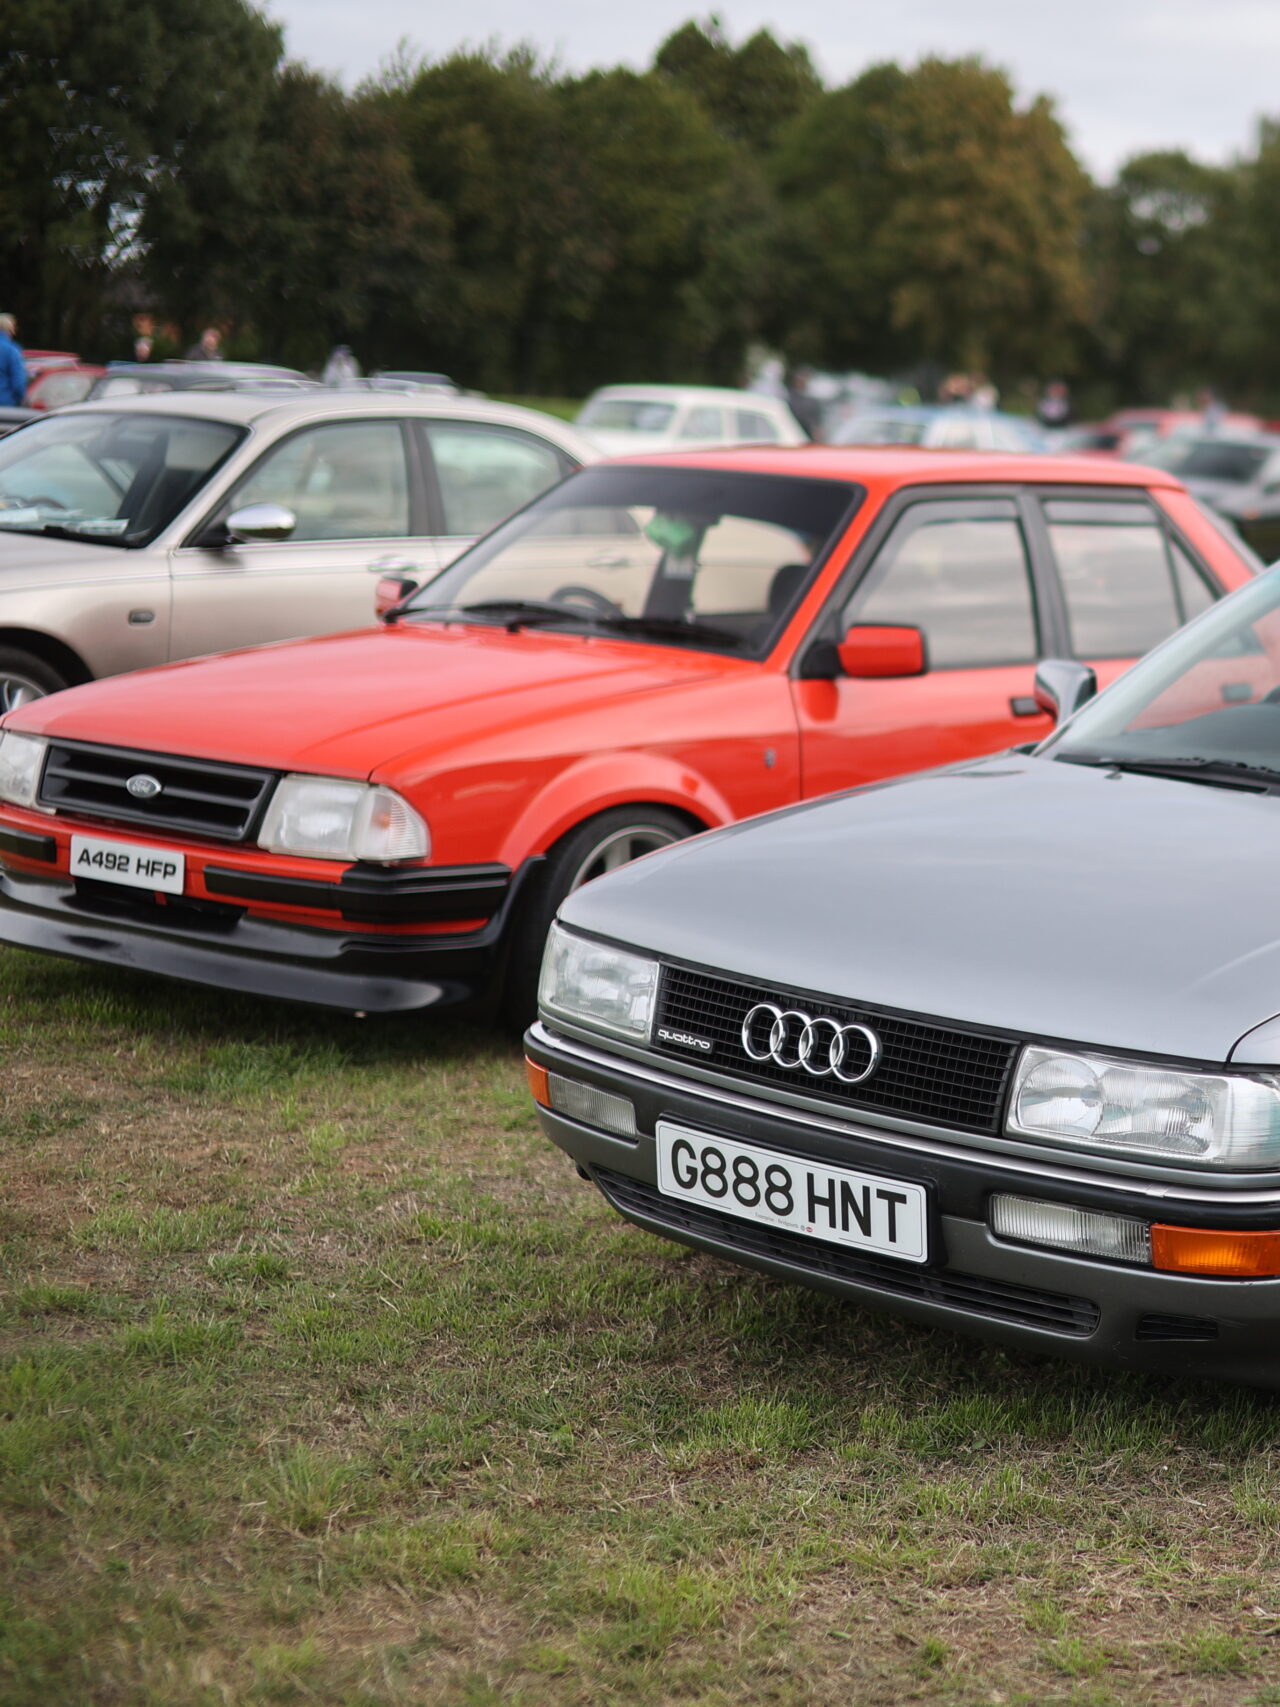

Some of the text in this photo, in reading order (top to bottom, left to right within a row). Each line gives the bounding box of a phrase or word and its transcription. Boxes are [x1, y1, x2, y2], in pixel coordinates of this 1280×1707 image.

[77, 849, 177, 880] A492 HFP
[658, 1029, 710, 1050] quattro
[671, 1139, 907, 1243] G888 HNT
